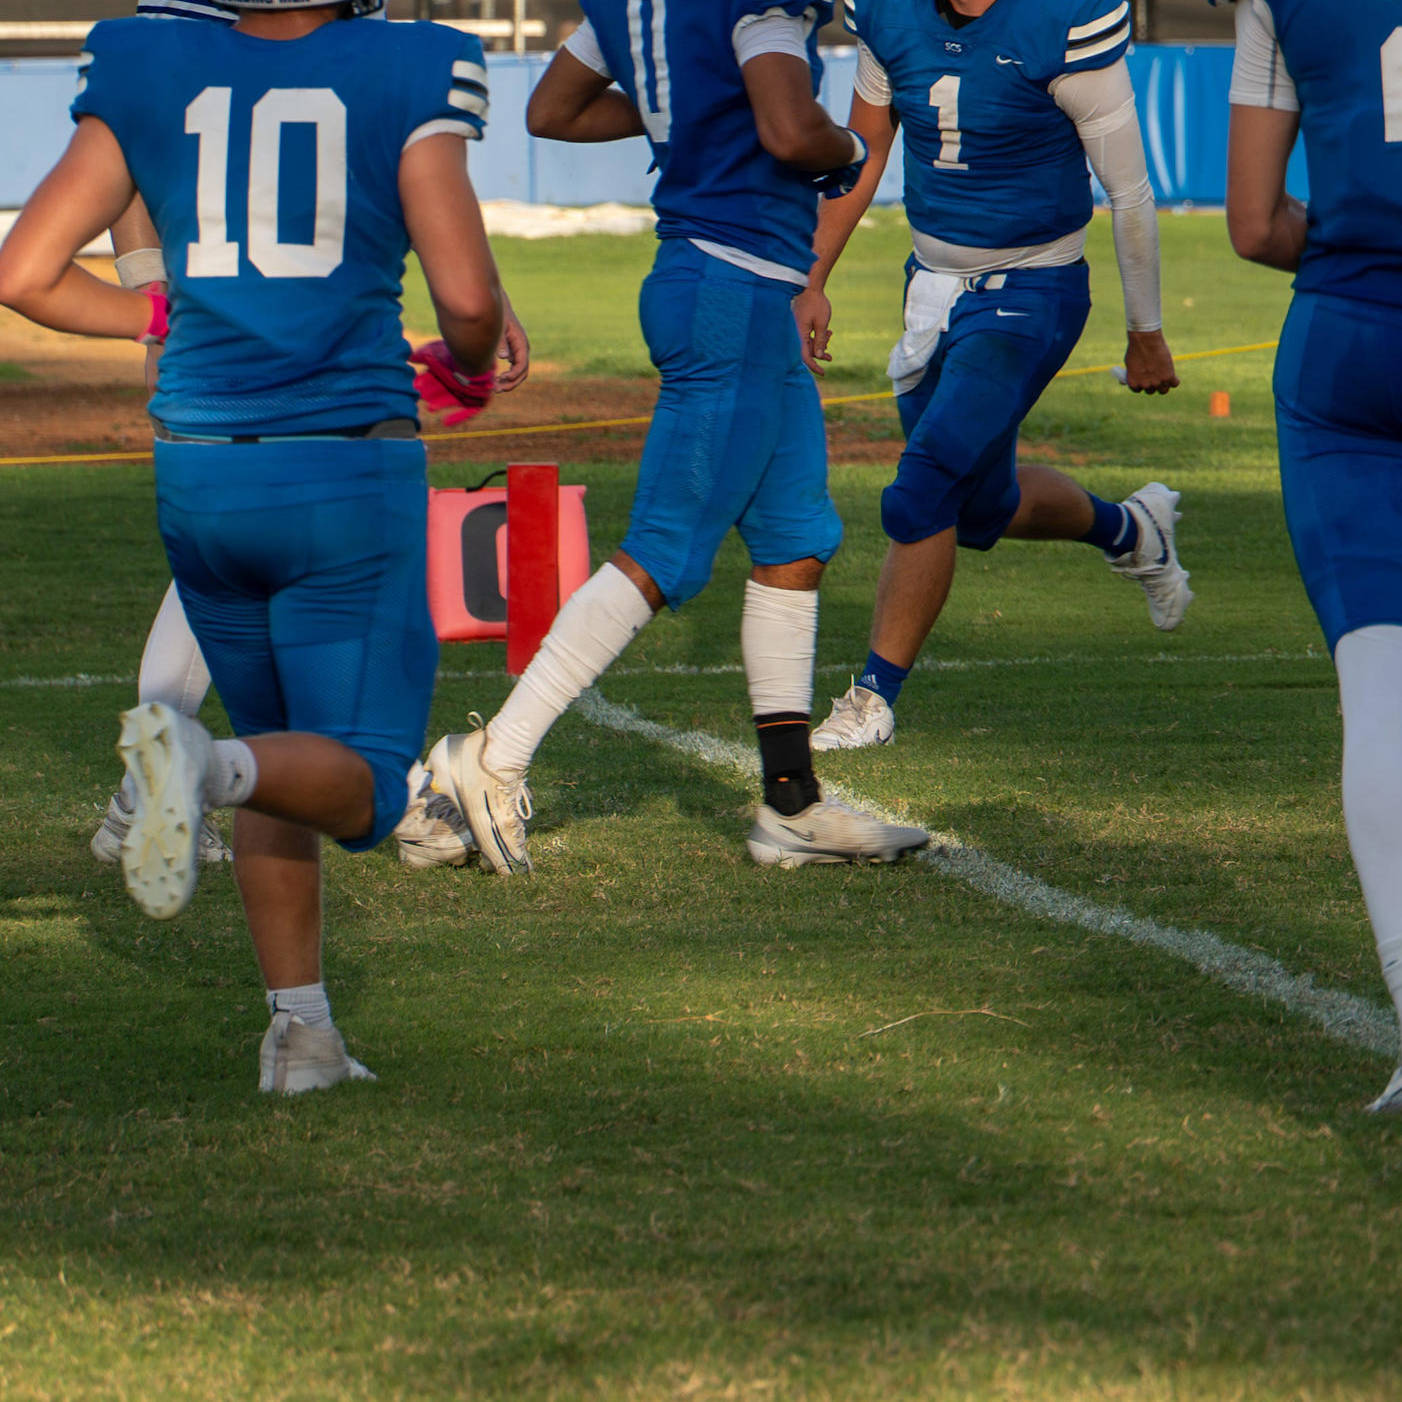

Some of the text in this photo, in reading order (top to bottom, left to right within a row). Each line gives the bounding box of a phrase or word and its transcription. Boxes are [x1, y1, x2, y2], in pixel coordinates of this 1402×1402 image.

[944, 41, 963, 53] SCS
[929, 74, 969, 171] 1
[185, 86, 347, 278] 10
